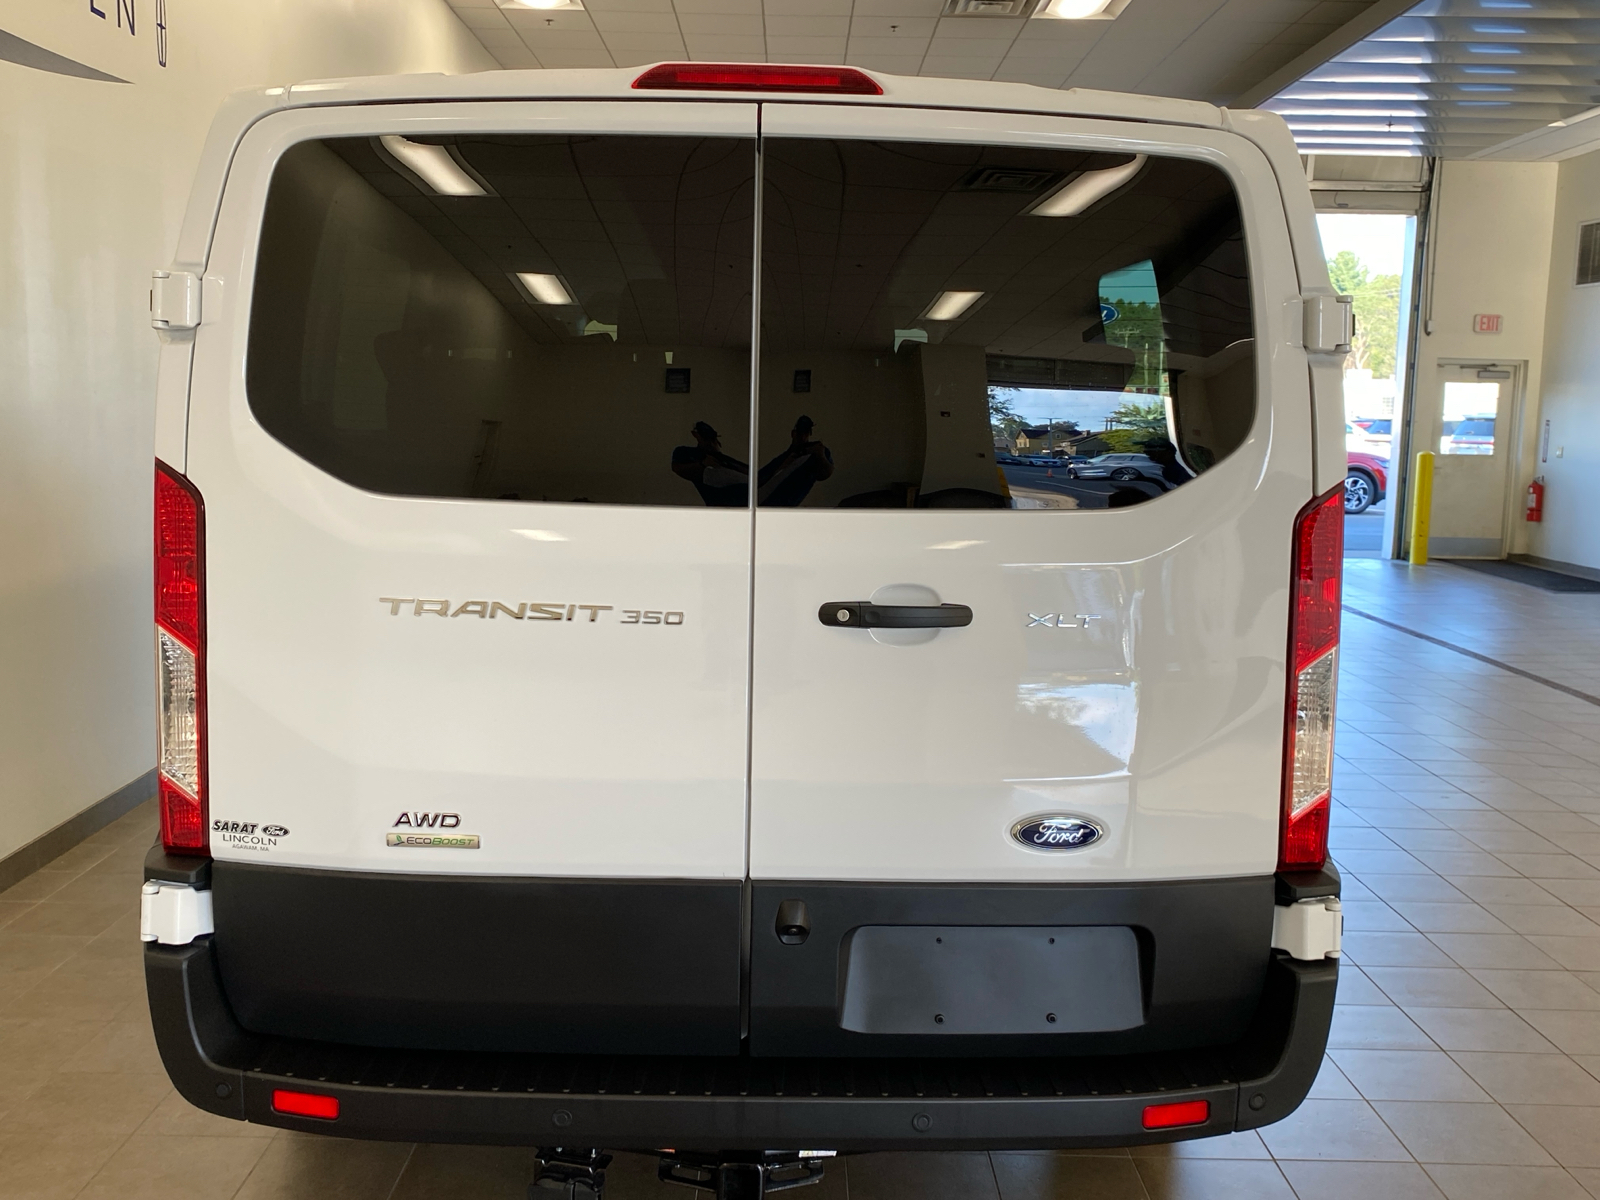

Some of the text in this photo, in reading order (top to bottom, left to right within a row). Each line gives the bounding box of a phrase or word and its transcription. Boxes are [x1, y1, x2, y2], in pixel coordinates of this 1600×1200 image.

[1480, 315, 1500, 331] EXIT
[379, 597, 684, 626] TRANSIT 350
[1026, 612, 1102, 629] XLT
[213, 819, 258, 834] SARAT
[392, 811, 461, 829] AWD
[223, 834, 277, 846] LINCOLN
[406, 836, 475, 846] ECOBOOST
[1033, 822, 1091, 844] Ford
